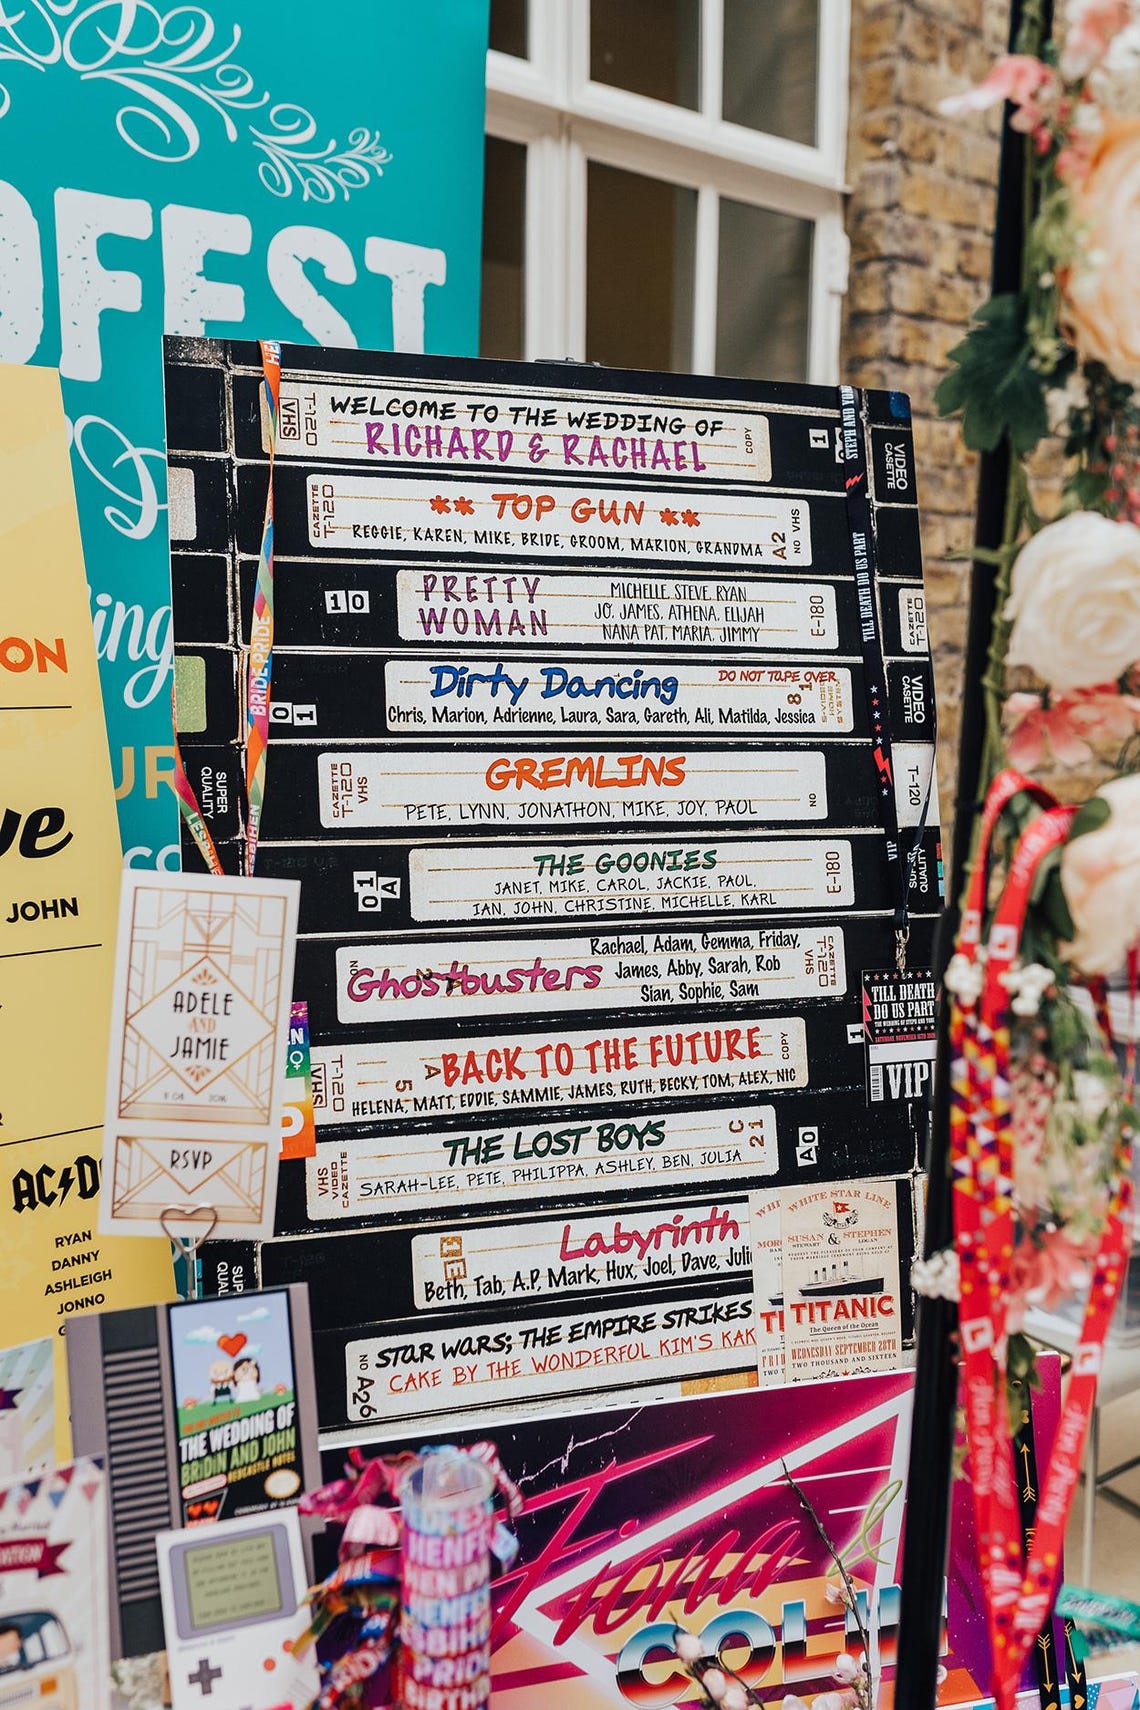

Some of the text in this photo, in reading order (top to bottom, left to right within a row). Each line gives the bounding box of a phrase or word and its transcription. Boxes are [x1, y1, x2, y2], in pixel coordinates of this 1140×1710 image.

[281, 401, 297, 438] VHS
[329, 395, 724, 438] WELCOME TO THE WEDDING OF
[365, 421, 707, 473] RICHARD & RACHAEL
[744, 426, 753, 455] COPY
[842, 407, 859, 460] STEPH AND
[884, 442, 896, 490] CASETTE
[893, 443, 909, 491] VIDEO
[490, 492, 646, 526] TOP GUN
[351, 523, 764, 558] REGGIE, KAREN, MIKE, BRIDE, GROOM, MARION, GRANDMA
[853, 531, 867, 558] PART
[856, 560, 869, 574] US
[421, 573, 541, 604] PRETTY
[716, 585, 747, 603] RYAN
[857, 577, 870, 591] DO
[417, 606, 549, 636] WOMAN
[724, 606, 765, 624] ELIJAH
[859, 593, 873, 622] DEATH
[602, 624, 761, 644] NANA JIMMY
[250, 615, 271, 717] BRIDE PRIDE
[717, 669, 766, 683] DO NOT
[429, 662, 680, 706] Dirty Dancing
[901, 674, 914, 724] CASETTE
[911, 674, 925, 724] VIDEO
[387, 705, 816, 726] Chris, Marion, Adrienne, Laura, Sara, Gareth, Ali, Matilda, Jessica
[485, 754, 687, 791] GREMLINS
[200, 766, 214, 820] QUALITY
[215, 771, 229, 814] SUPER
[357, 776, 369, 805] VHS
[715, 799, 758, 816] PAUL
[533, 849, 718, 877] THE GOONIES
[917, 848, 929, 893] QUALITY
[5, 896, 79, 923] JOHN
[741, 892, 777, 907] KARL
[590, 930, 802, 956] Rachael, Adam, Gemma, Friday,
[346, 956, 603, 1003] Ghostbusters
[614, 954, 781, 980] James, Abby, Sarah, Rob
[173, 990, 234, 1016] ADELE
[640, 981, 760, 1003] Sian, Sophie, Sam
[871, 982, 936, 1003] TILL DEATH
[873, 1000, 935, 1020] DO US PART
[169, 1036, 230, 1061] JAMIE
[441, 1025, 762, 1088] BACK TO THE FUTURE
[780, 1031, 790, 1061] COPY
[351, 1067, 796, 1118] HELENA, MATT, EDDIE, SAMMIE, JAMES, RUTH, BECKY, TOM, ALEX, NIC
[885, 1061, 930, 1100] VIP
[442, 1119, 667, 1168] THE LOST BOYS
[700, 1149, 743, 1165] JULIA
[169, 1149, 213, 1169] RSVP
[317, 1166, 329, 1197] VHS
[787, 1189, 892, 1213] WHITE STAR LINE
[54, 1230, 93, 1249] RYAN
[559, 1206, 740, 1262] Labyrinth
[51, 1250, 100, 1272] DANNY
[44, 1269, 113, 1296] ASHLEIGH
[423, 1251, 721, 1303] Beth, Tab, Mark, Hux, Joel, Dave,
[56, 1293, 106, 1315] JONNO
[790, 1294, 895, 1326] TITANIC
[518, 1298, 753, 1350] THE EMPIRE STRIKES
[388, 1368, 443, 1394] CAKE
[452, 1364, 478, 1385] BY
[486, 1358, 522, 1380] THE
[531, 1342, 651, 1374] WONDERFUL
[659, 1333, 714, 1357] KIM'S
[791, 1352, 898, 1369] TWO THOUSAND AND SIXTEEN
[178, 1430, 209, 1463] THE
[209, 1408, 276, 1453] WEDDING
[276, 1402, 296, 1430] OF
[230, 1439, 260, 1469] AND
[262, 1426, 297, 1459] JOHN
